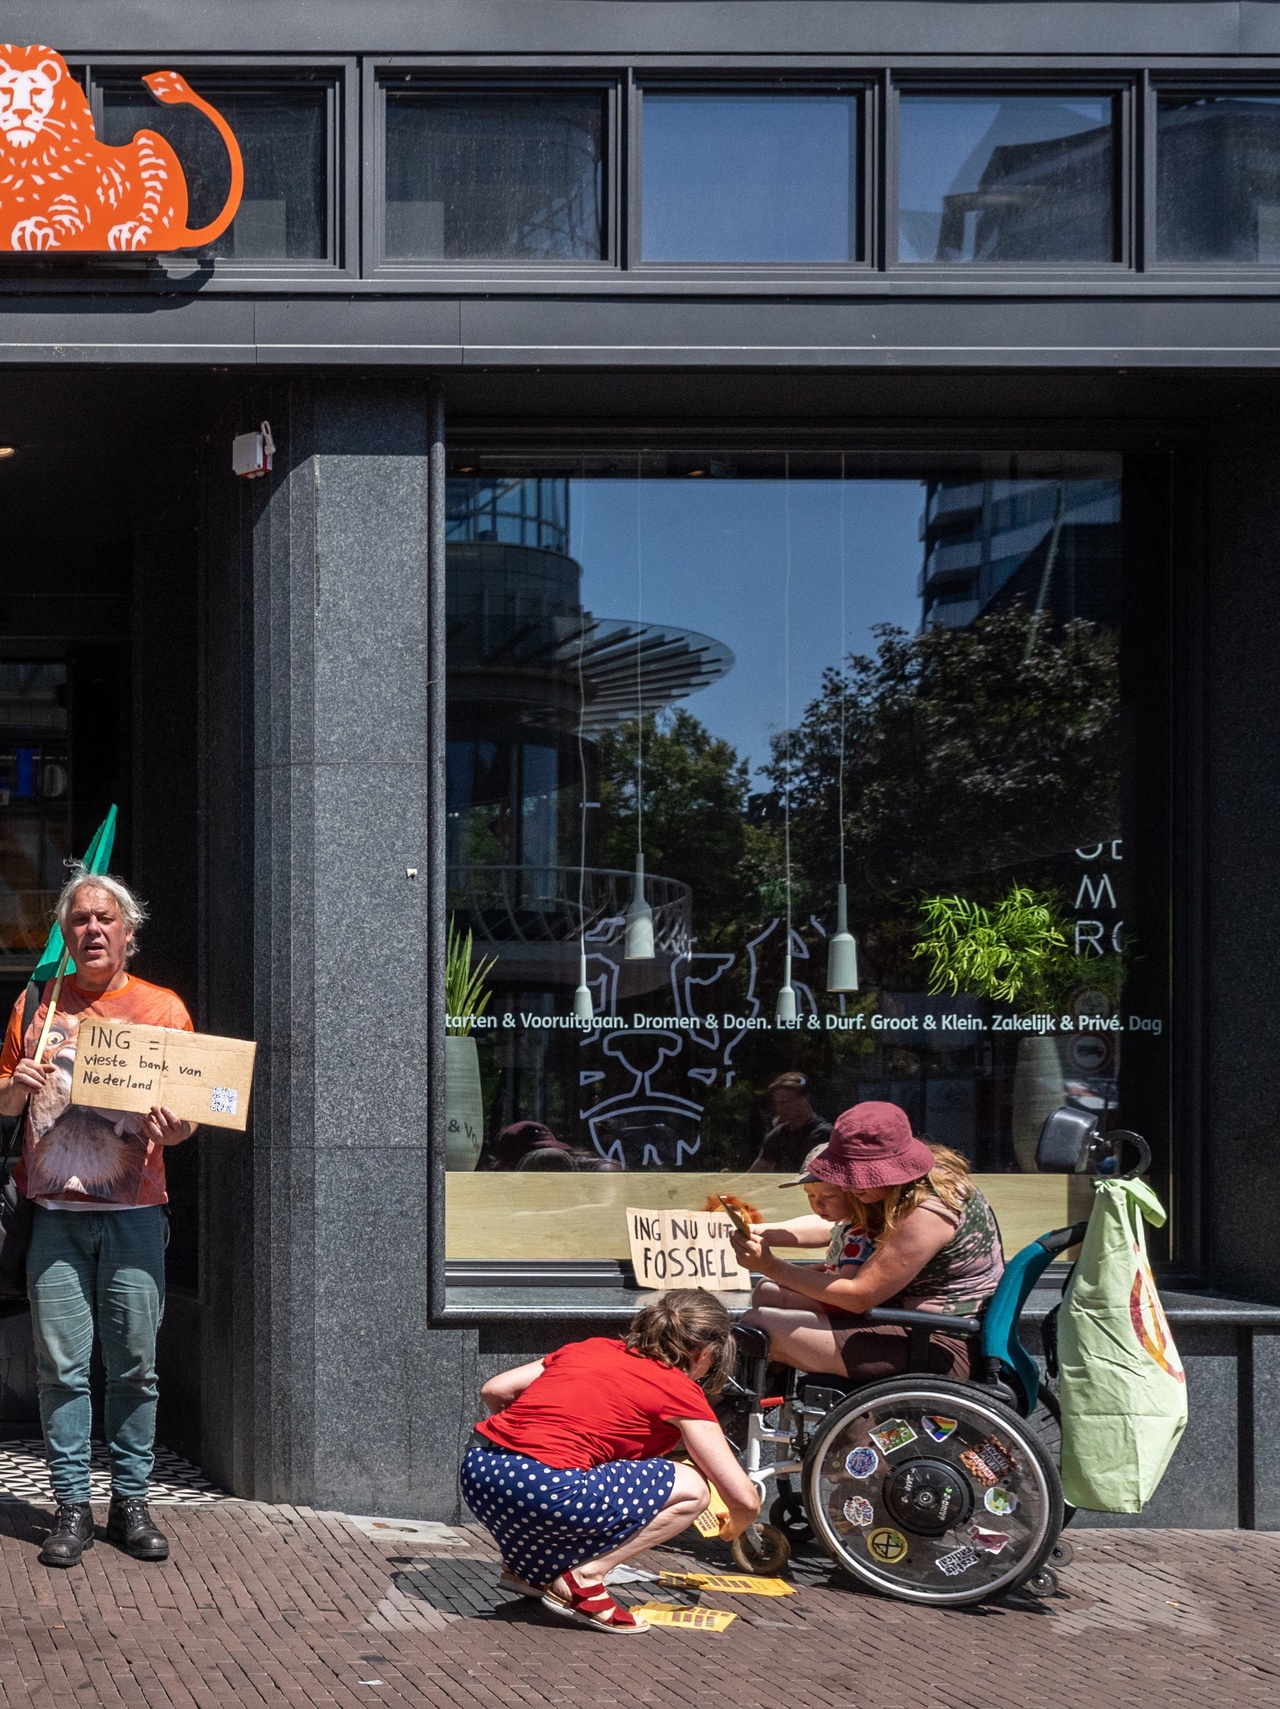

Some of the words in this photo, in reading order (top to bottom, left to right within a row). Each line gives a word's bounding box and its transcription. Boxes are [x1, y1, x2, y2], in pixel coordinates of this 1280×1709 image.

[502, 1013, 516, 1029] &
[520, 1012, 629, 1033] Vooruitgaan.
[633, 1013, 700, 1029] Dromen
[705, 1013, 719, 1029] &
[724, 1014, 771, 1029] Doen.
[777, 1013, 803, 1029] Lef
[807, 1014, 821, 1030] &
[826, 1013, 866, 1030] Durf.
[871, 1014, 918, 1030] Groot
[923, 1014, 937, 1030] &
[941, 1014, 988, 1031] Klein.
[992, 1014, 1056, 1034] Zakelijk
[1060, 1014, 1074, 1031] &
[1078, 1013, 1124, 1031] Privé.
[1129, 1015, 1163, 1035] Dag
[90, 1026, 131, 1050] ING
[149, 1040, 160, 1051] =
[84, 1053, 128, 1068] vieste
[139, 1055, 169, 1072] bank
[179, 1066, 202, 1077] van
[83, 1072, 153, 1091] Nederland
[448, 1119, 460, 1133] &
[634, 1215, 662, 1241] ING
[671, 1219, 699, 1240] NU
[708, 1222, 733, 1239] UIT
[644, 1247, 738, 1279] FOSSIEL
